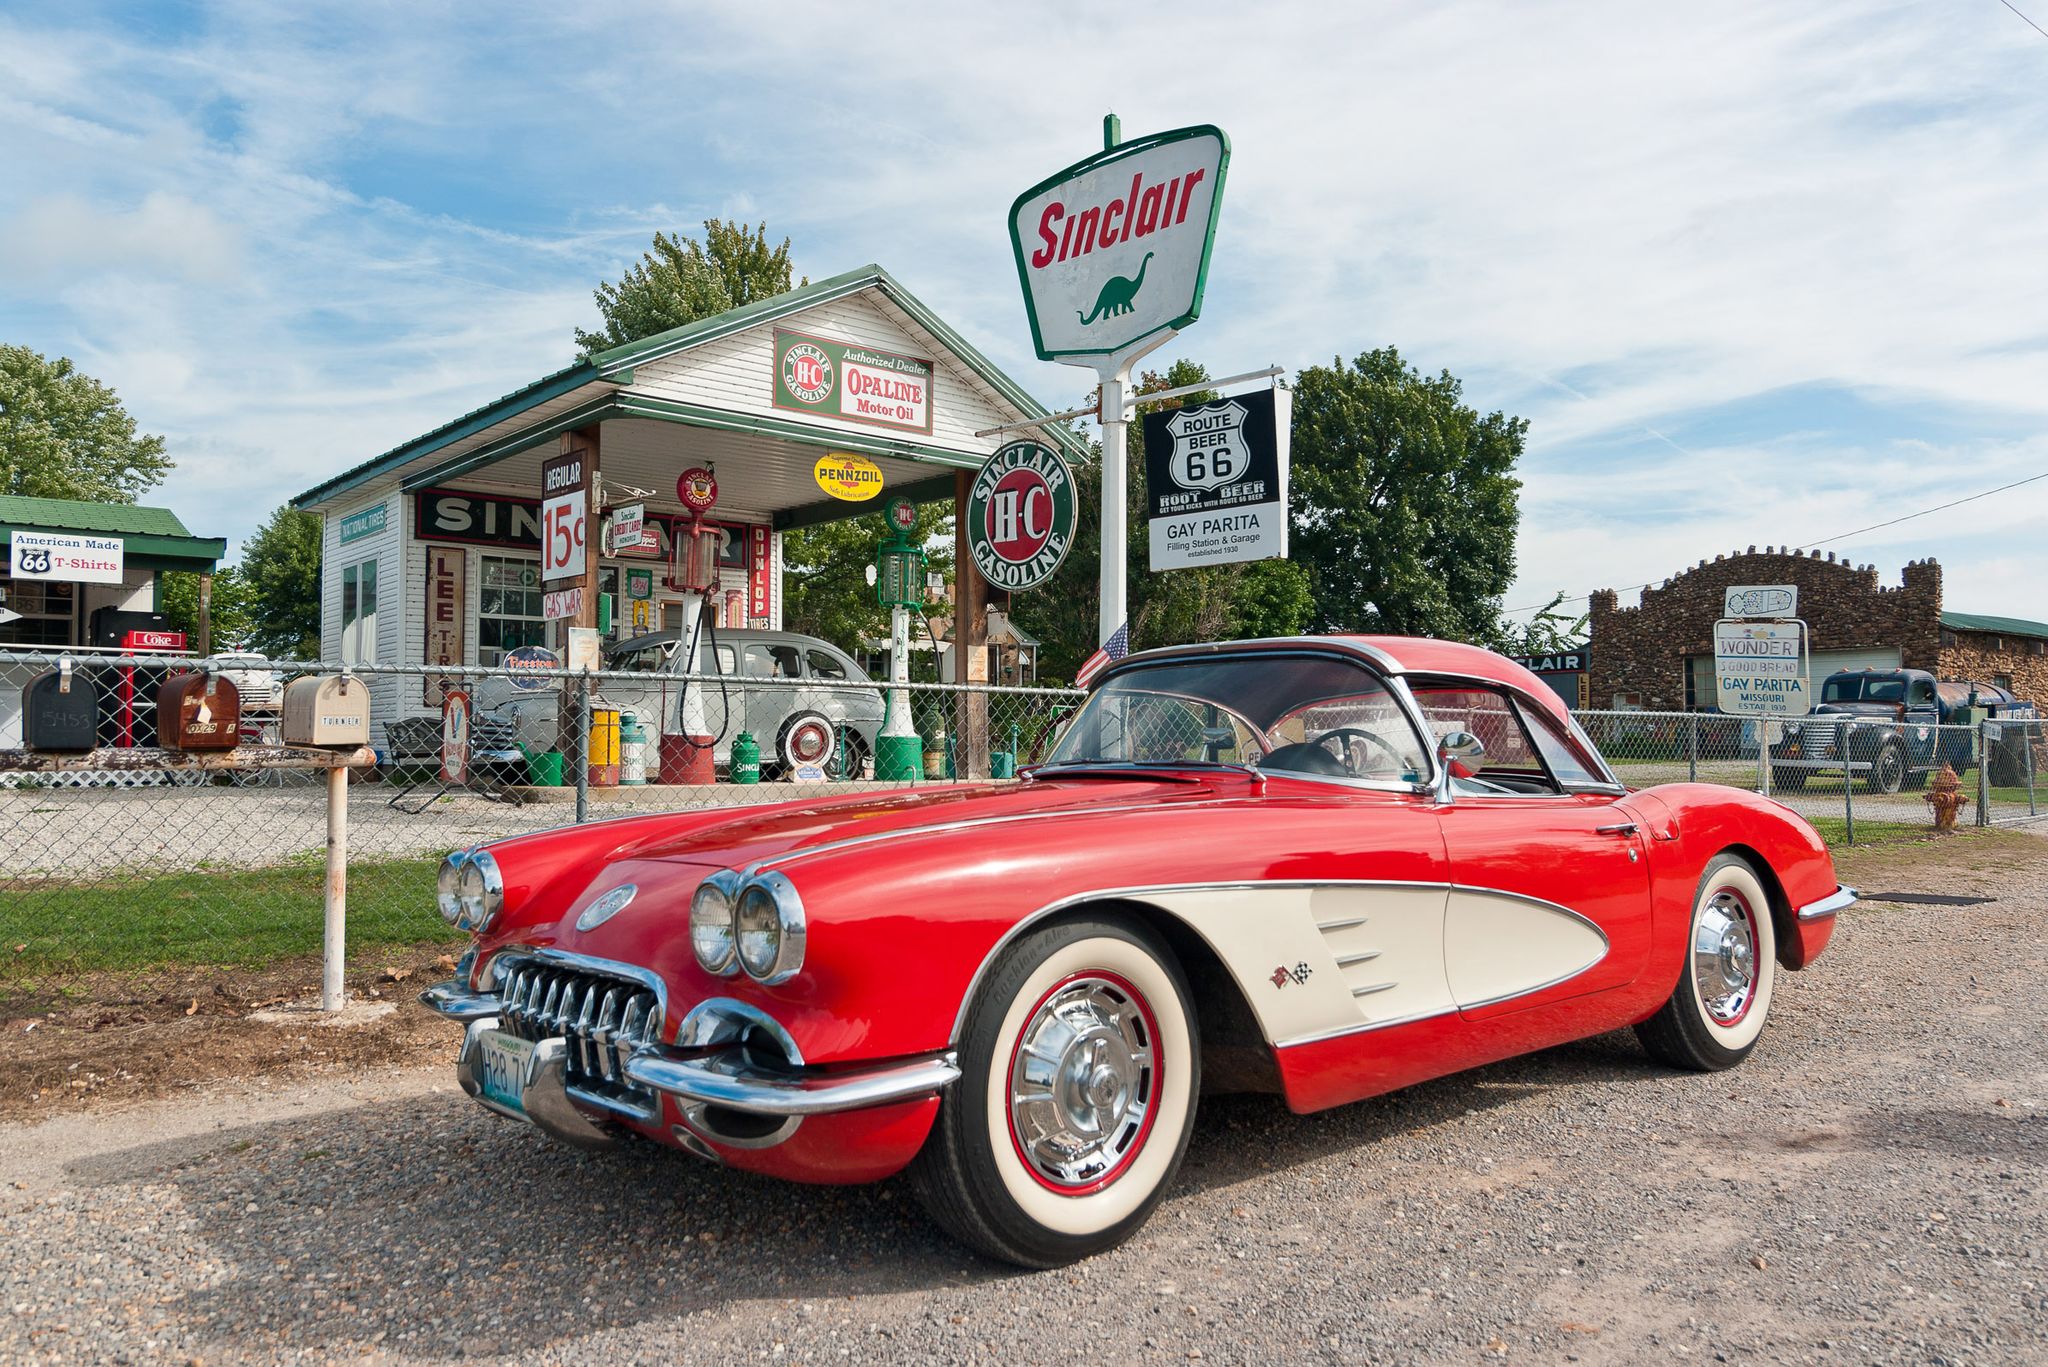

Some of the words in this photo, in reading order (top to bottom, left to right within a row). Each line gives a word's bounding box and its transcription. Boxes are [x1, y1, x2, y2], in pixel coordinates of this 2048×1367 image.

[1031, 167, 1205, 269] Sinclair
[787, 345, 830, 375] SINCLAIR
[843, 349, 894, 369] Authorized
[896, 360, 926, 376] Dealer
[785, 374, 831, 401] GASOLINE
[847, 368, 922, 405] OPALINE
[856, 398, 894, 417] Motor
[896, 405, 914, 421] Oil
[1183, 413, 1231, 433] ROUTE
[1189, 432, 1227, 450] BEER
[819, 468, 881, 482] PENNZOIL
[975, 447, 1065, 502] SINCLAIR
[1186, 448, 1232, 481] 66
[547, 461, 581, 491] REGULAR
[685, 473, 715, 488] SINCLAIR
[686, 491, 714, 505] GASOLINE
[1160, 490, 1200, 507] ROOT
[1220, 481, 1264, 498] BEER
[1186, 502, 1202, 510] KICKS
[1204, 500, 1218, 508] WITH
[342, 516, 368, 538] NATIONAL
[368, 510, 384, 528] TIRES
[1167, 522, 1197, 539] GAY
[1202, 514, 1260, 535] PARITA
[16, 535, 80, 548] American
[86, 540, 119, 550] Made
[1167, 541, 1190, 551] Filling
[1191, 538, 1219, 549] Station
[1222, 536, 1228, 544] &
[1231, 534, 1260, 544] Garage
[1188, 548, 1222, 557] established
[1224, 546, 1238, 554] 1930
[22, 554, 48, 571] 66
[55, 557, 117, 571] T-Shirts
[975, 532, 1066, 586] GASOLINE
[755, 528, 765, 614] DUNLOP
[437, 557, 454, 622] LEE
[545, 591, 561, 619] GAS
[563, 589, 582, 615] WAR
[750, 618, 769, 630] TIRES
[143, 632, 172, 645] Coke
[1721, 641, 1792, 655] WONDER
[439, 630, 451, 691] TIRS
[1728, 662, 1756, 672] GOOD
[1761, 663, 1797, 673] BREAD
[1723, 677, 1749, 690] GAY
[1740, 693, 1785, 702] MISSOURI
[737, 763, 759, 773] SINCL
[483, 1045, 507, 1093] H28
